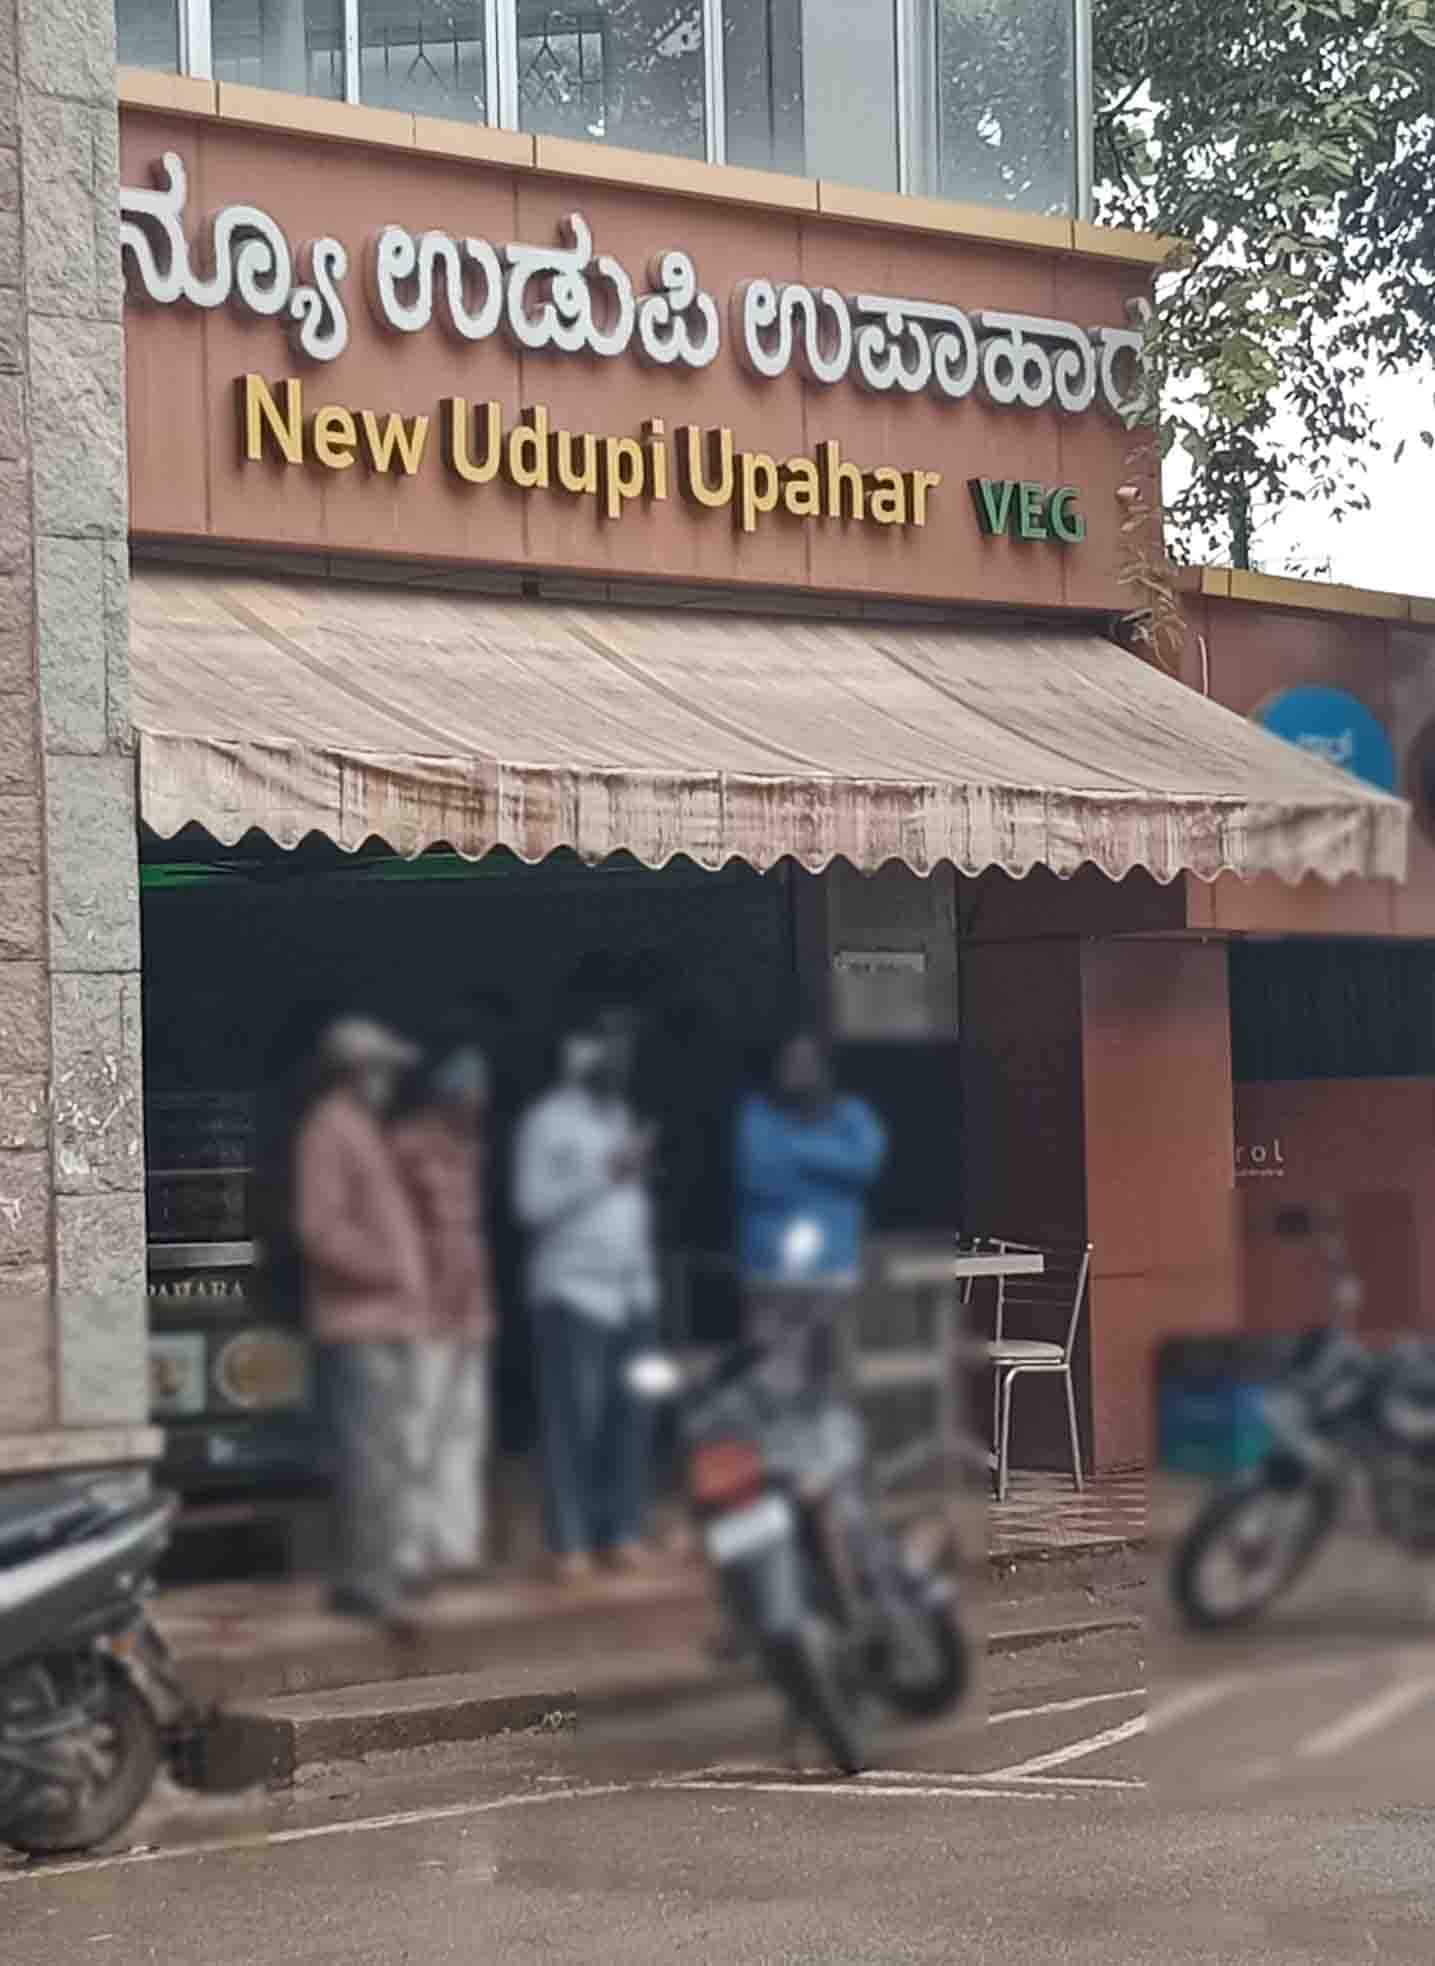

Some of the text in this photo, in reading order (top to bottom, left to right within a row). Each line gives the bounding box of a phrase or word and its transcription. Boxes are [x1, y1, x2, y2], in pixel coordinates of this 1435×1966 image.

[377, 212, 719, 367] ಉಡುಪಿ
[245, 373, 1086, 544] New Udupi Upahar VEG
